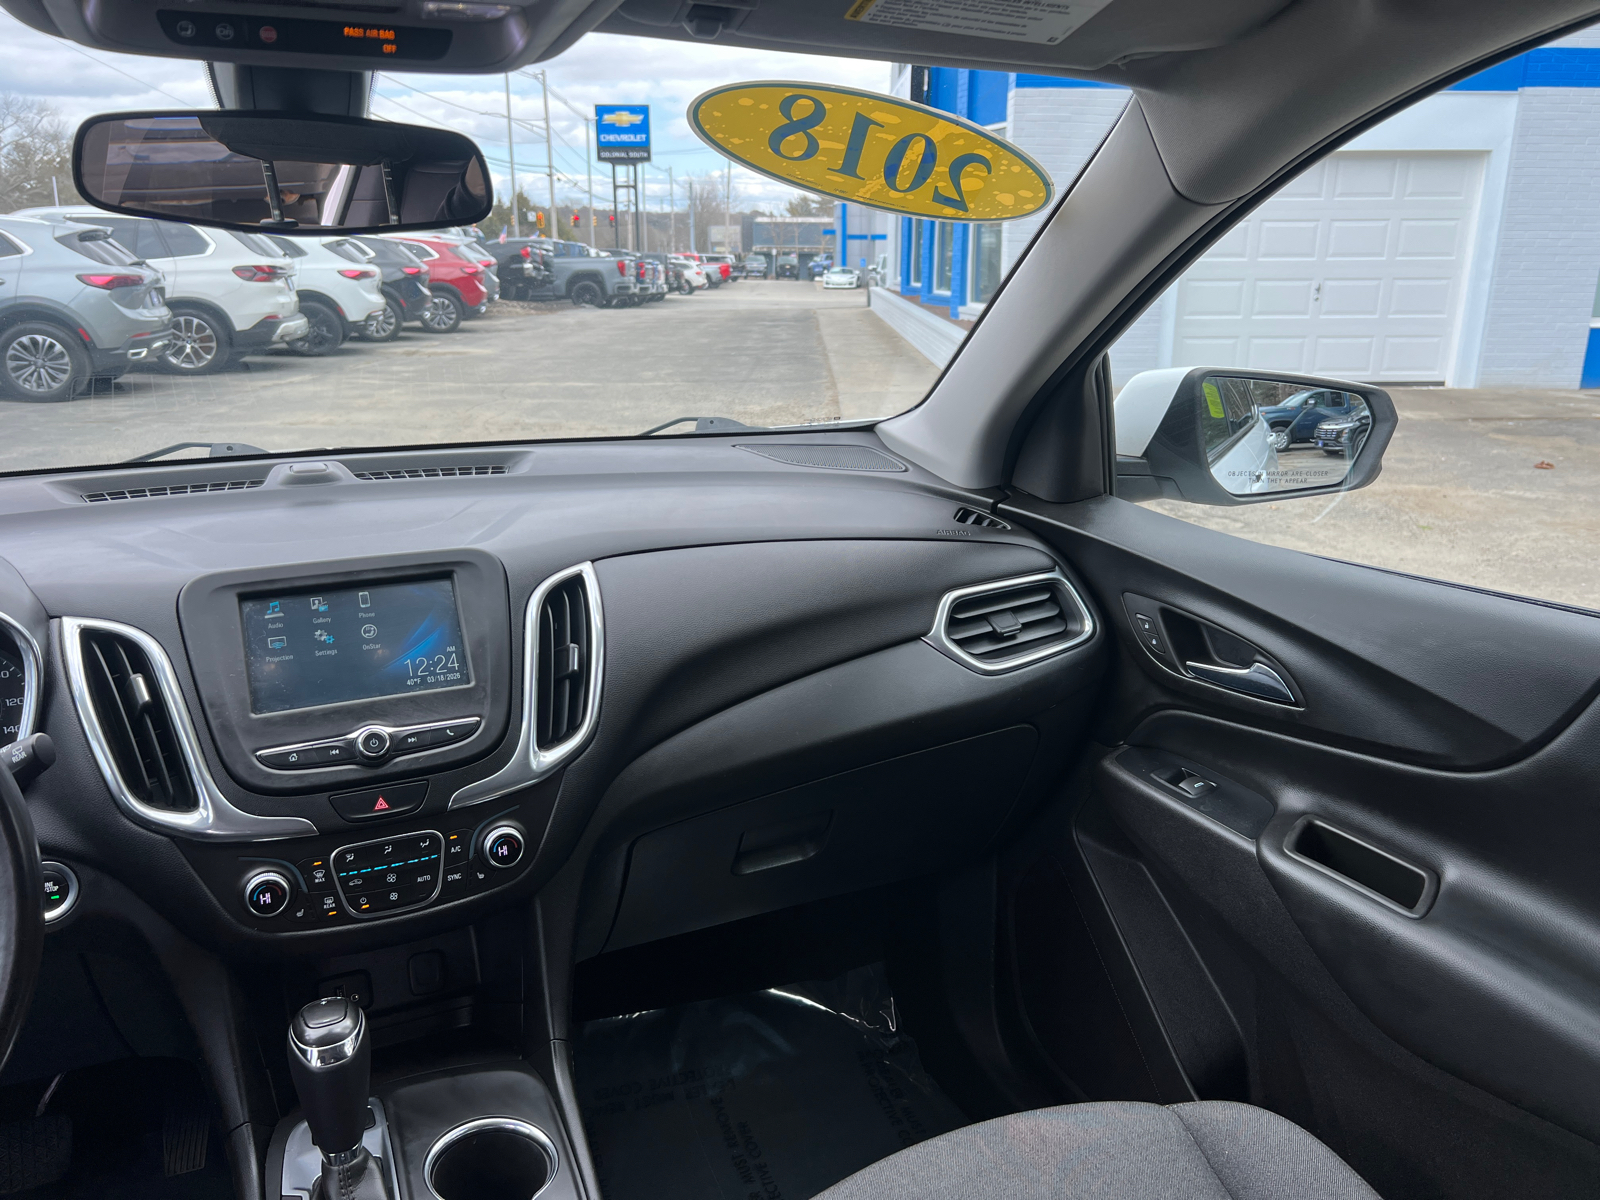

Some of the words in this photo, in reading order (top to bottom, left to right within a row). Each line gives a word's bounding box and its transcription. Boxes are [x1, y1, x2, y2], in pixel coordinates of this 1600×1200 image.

[343, 26, 364, 37] PASS
[366, 28, 379, 38] AIR
[379, 29, 396, 40] BAG
[382, 43, 397, 54] OFF
[600, 134, 647, 142] CHEVROLET
[600, 151, 628, 159] COLONIAL
[628, 151, 648, 159] SOUTH
[312, 616, 332, 624] Gallery
[267, 622, 284, 630] Audio
[362, 643, 382, 651] OnStar
[446, 645, 456, 653] AM
[314, 648, 338, 657] Settings
[265, 654, 294, 663] Projection
[404, 653, 460, 677] 12:24
[11, 751, 27, 764] REAR
[450, 845, 462, 854] A/C
[416, 874, 431, 883] AUTO
[447, 872, 462, 882] SYNC
[323, 902, 336, 910] REAR
[737, 1120, 762, 1160] COVER
[754, 1162, 782, 1200] ECTIVE
